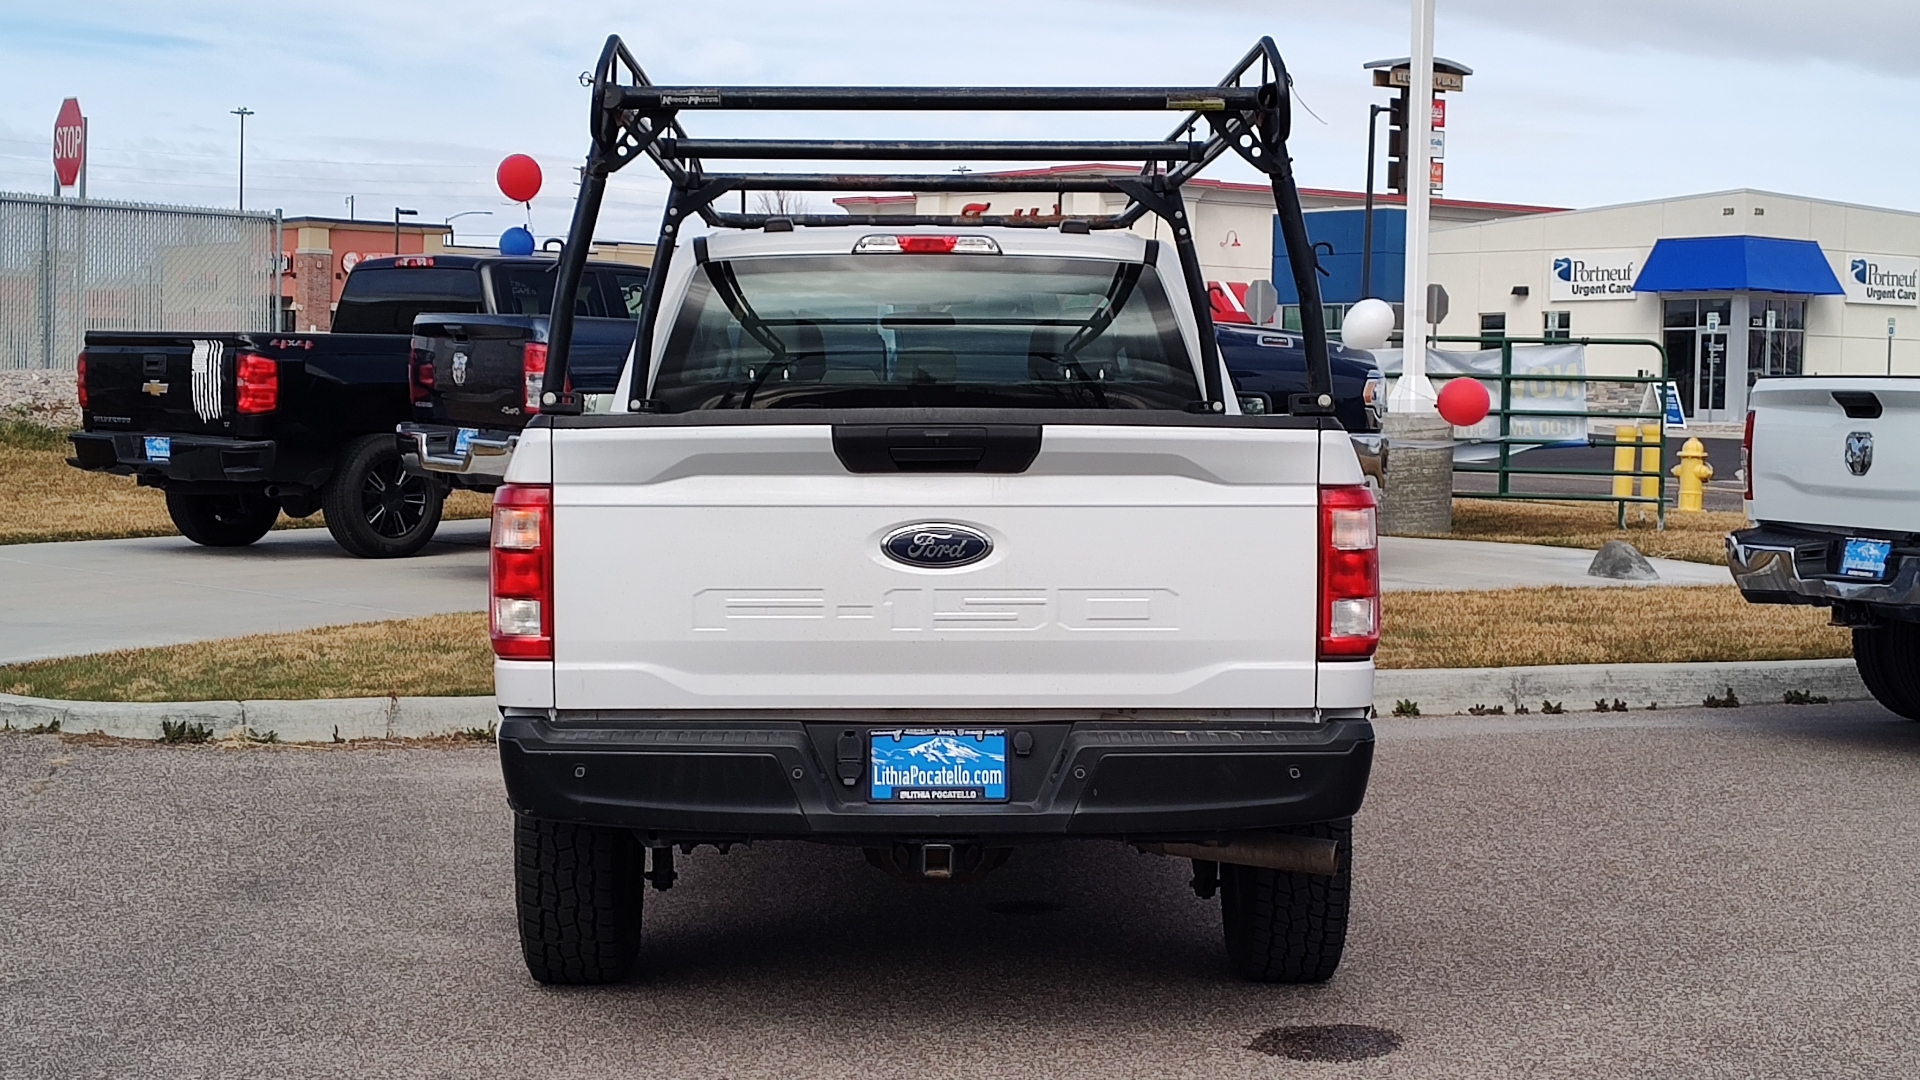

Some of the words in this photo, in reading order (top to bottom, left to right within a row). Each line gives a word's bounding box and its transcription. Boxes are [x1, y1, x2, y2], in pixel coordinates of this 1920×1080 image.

[55, 126, 82, 159] STOP
[1573, 260, 1633, 282] Portneuf
[1867, 263, 1918, 288] Portneuf
[1571, 283, 1606, 297] Urgent
[1608, 283, 1632, 294] Care
[1866, 287, 1895, 300] Urgent
[1897, 288, 1917, 301] Care
[907, 532, 968, 558] Ford
[692, 587, 1180, 632] F-150
[873, 764, 1002, 786] LithiaPocatello.com
[931, 790, 977, 799] POCATELLO
